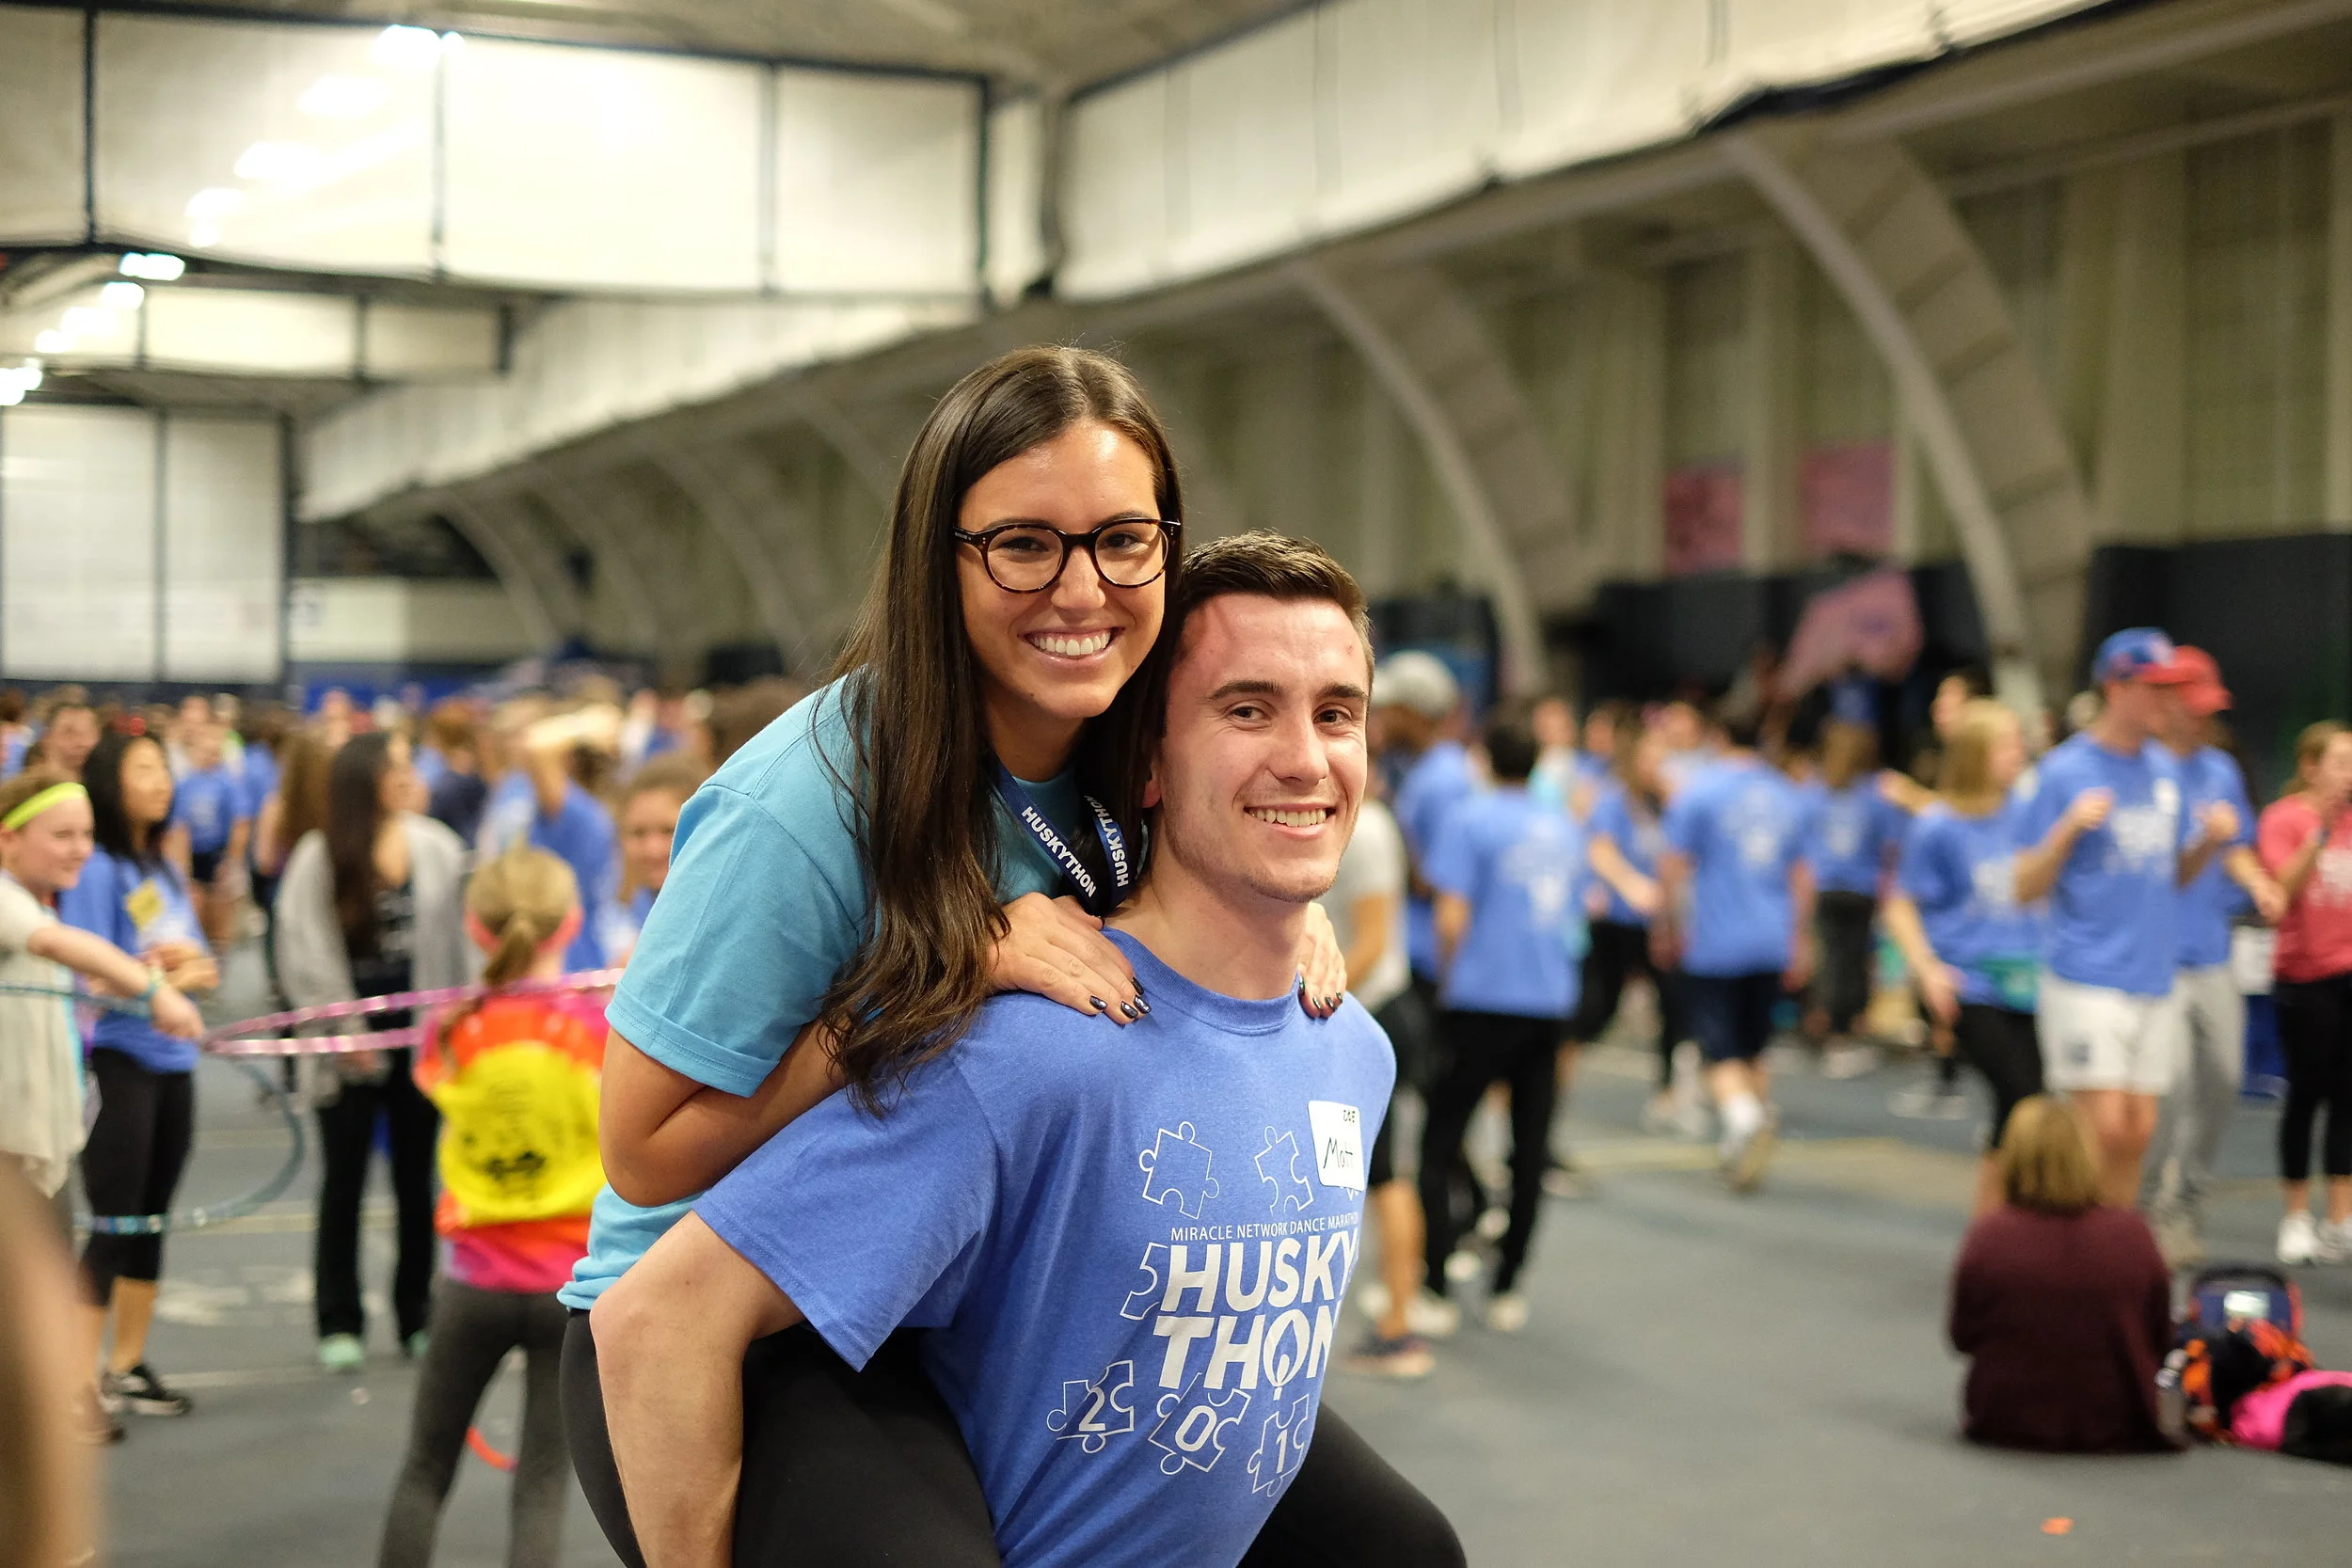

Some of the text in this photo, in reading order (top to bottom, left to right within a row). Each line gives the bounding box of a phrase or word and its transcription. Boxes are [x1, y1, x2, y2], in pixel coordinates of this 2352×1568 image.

[1022, 806, 1096, 897] HUSKYTHON
[1084, 795, 1129, 887] HUSKYTHON
[1160, 1228, 1359, 1313] HUSKY
[1170, 1226, 1232, 1241] MIRACLE
[1237, 1222, 1288, 1239] NETWORK
[1290, 1217, 1326, 1234] DANCE
[1079, 1386, 1288, 1473] 2 0 1
